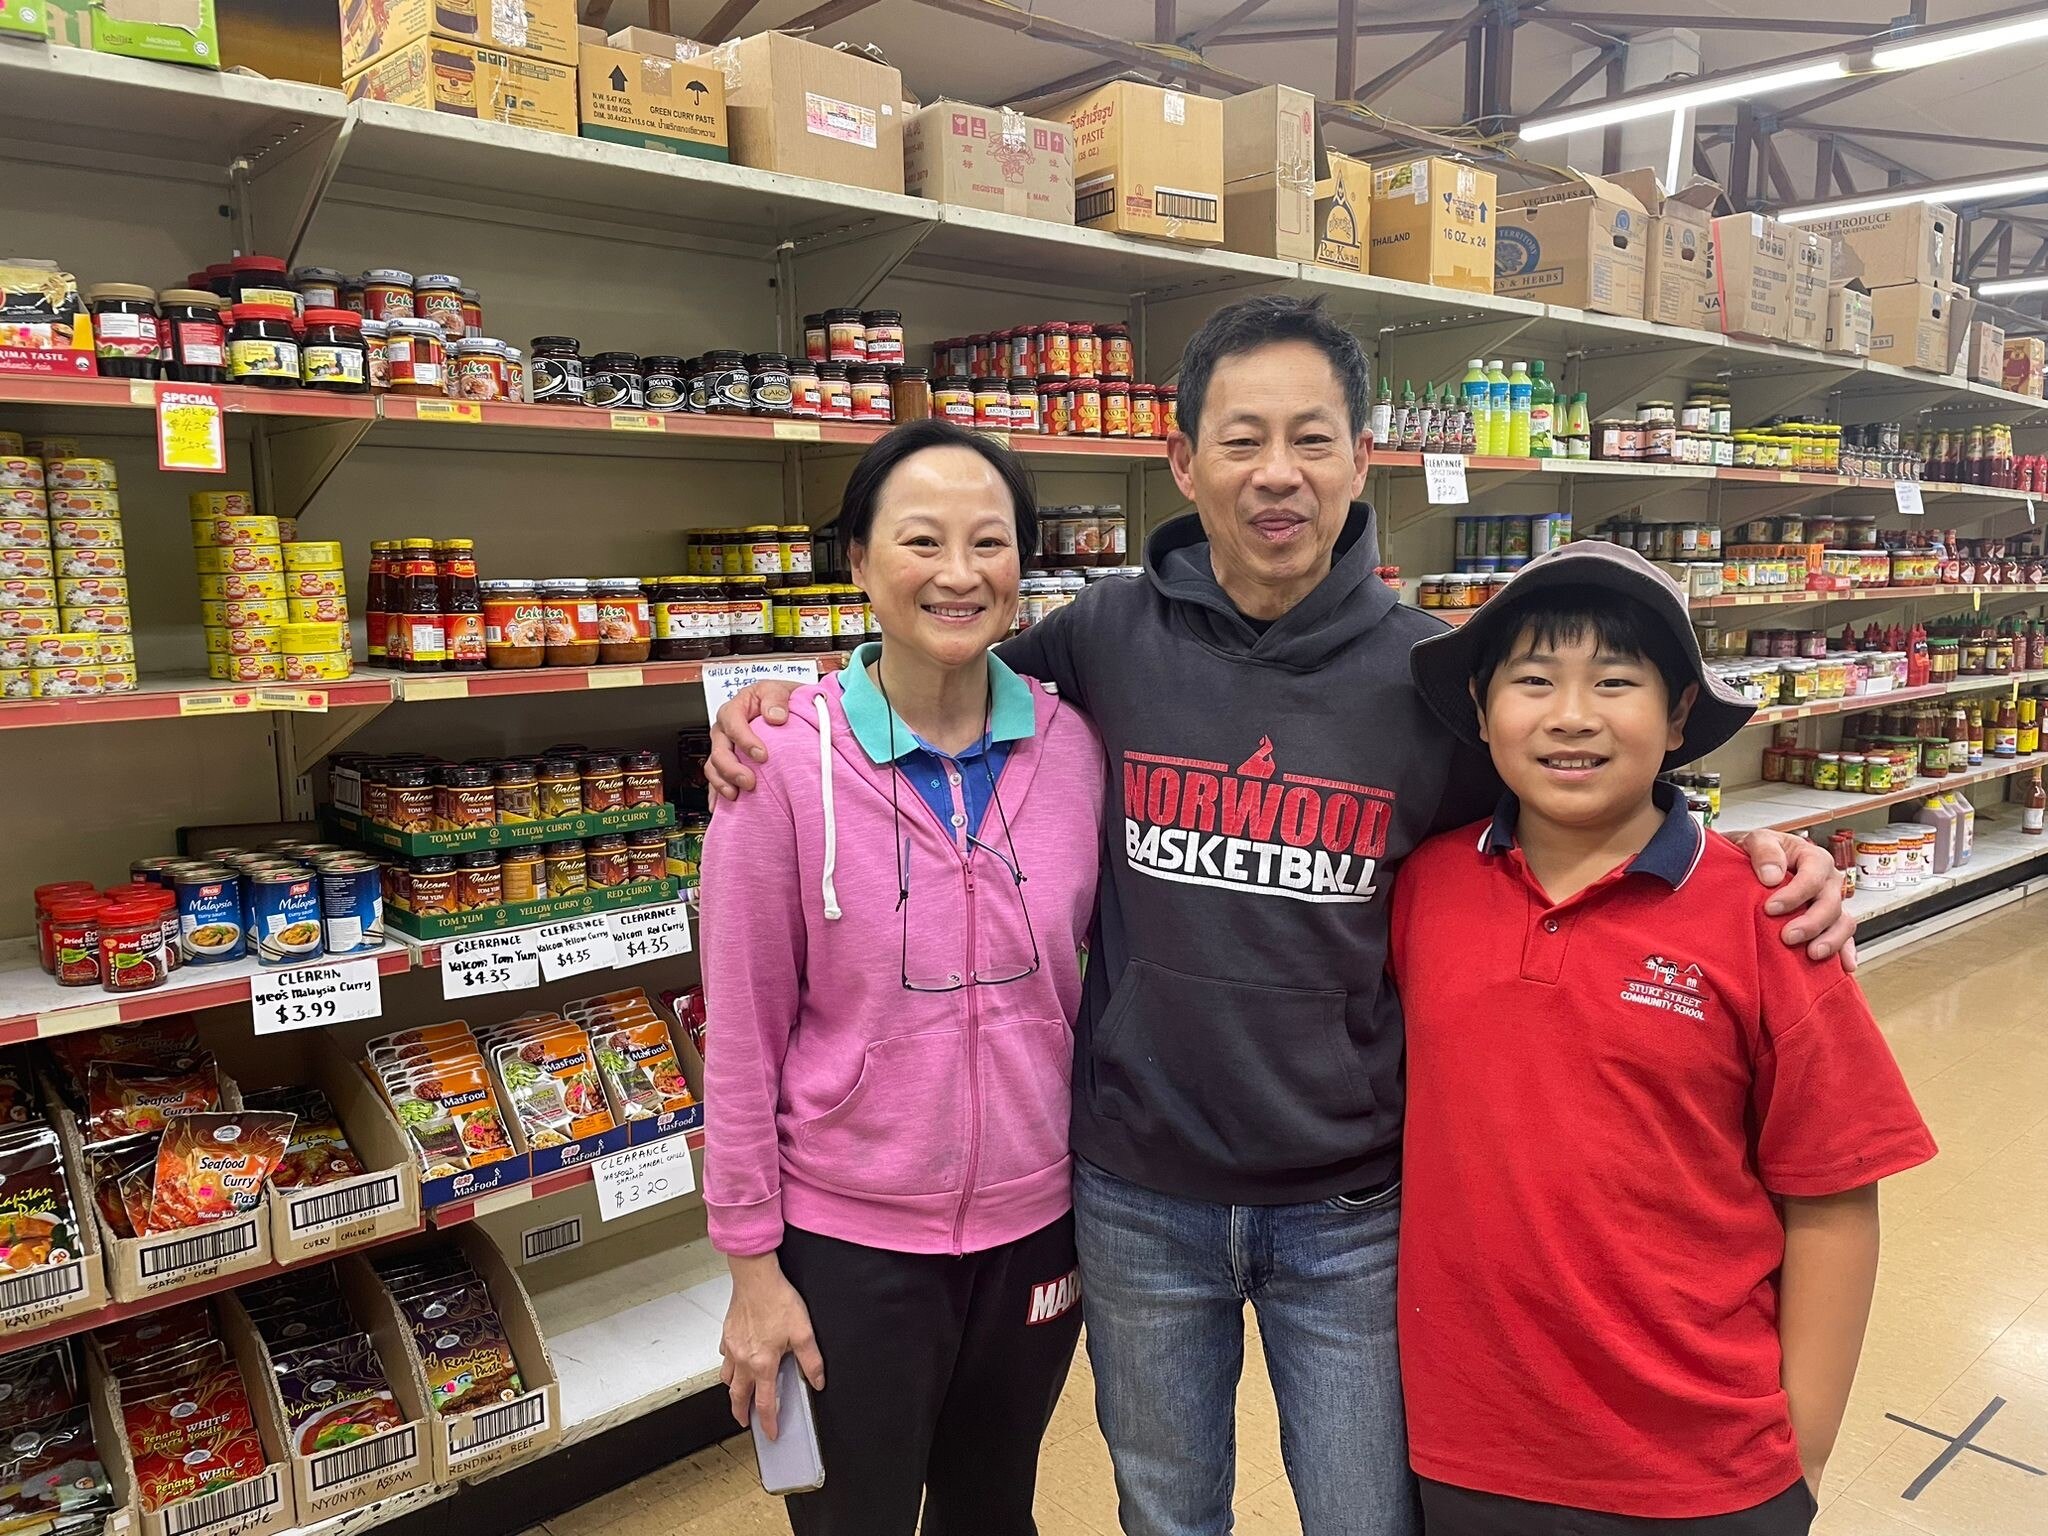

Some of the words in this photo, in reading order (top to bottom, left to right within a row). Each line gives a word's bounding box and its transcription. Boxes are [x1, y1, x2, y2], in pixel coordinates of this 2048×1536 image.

[649, 106, 672, 117] GREEN
[673, 110, 694, 121] CURRY
[695, 114, 715, 125] PASTE
[1081, 128, 1105, 146] PASTE
[1835, 212, 1892, 228] PRODUCE
[1372, 232, 1411, 248] THAILAND
[1443, 228, 1452, 241] 16
[1454, 230, 1468, 244] OZ.
[1476, 236, 1486, 248] 24
[1320, 242, 1334, 257] Por
[1336, 245, 1359, 265] Kwan
[1522, 274, 1559, 286] HERBS
[425, 296, 462, 311] Laksa
[0, 350, 28, 360] RIMA
[162, 392, 216, 406] SPECIAL
[602, 816, 620, 825] RED
[622, 812, 650, 822] CURRY
[1123, 761, 1392, 859] NORWOOD
[430, 834, 452, 844] TOM
[454, 831, 477, 842] YUM
[511, 825, 544, 837] YELLOW
[546, 822, 573, 833] CURRY
[1125, 817, 1378, 895] BASKETBALL
[607, 889, 624, 899] RED
[626, 885, 653, 897] CURRY
[189, 900, 233, 912] Malaysia
[278, 897, 317, 911] Malaysia
[520, 904, 551, 916] YELLOW
[554, 900, 580, 911] CURRY
[438, 916, 459, 927] TOM
[462, 913, 484, 924] YUM
[620, 906, 677, 925] CLEARANCE
[540, 917, 605, 938] CLEARANCE
[613, 930, 643, 943] Valcom
[648, 925, 660, 935] Red
[662, 922, 685, 934] Curry
[64, 937, 83, 945] Dried
[119, 940, 140, 950] Dried
[455, 935, 521, 955] CLEARANCE
[563, 935, 587, 948] Yellow
[588, 930, 609, 942] Curry
[627, 936, 669, 957] $4.35
[492, 952, 514, 965] Tom
[517, 950, 537, 962] Yum
[557, 949, 591, 967] $4.35
[463, 968, 511, 986] $4.35
[292, 985, 336, 1000] Malaysia
[340, 980, 371, 992] Curry
[1629, 982, 1662, 998] STURT
[1664, 990, 1702, 1008] STREET
[275, 1000, 336, 1025] $3.99
[1620, 990, 1672, 1010] COMMUNITY
[1673, 1003, 1705, 1021] SCHOOL
[631, 1043, 667, 1061] MasFood
[546, 1053, 586, 1073] MasFood
[136, 1091, 184, 1107] Seafood
[443, 1090, 486, 1108] MasFood
[163, 1107, 196, 1117] Curry
[657, 1117, 694, 1134] MasFood
[200, 1157, 247, 1171] Seafood
[562, 1148, 600, 1167] MasFood
[601, 1143, 669, 1170] CLEARANCE
[223, 1174, 256, 1188] Curry
[453, 1178, 498, 1198] MasFood
[234, 1191, 256, 1204] Pas
[19, 1199, 58, 1219] Paste
[303, 1236, 331, 1250] CURRY
[341, 1223, 375, 1240] CHICKEN
[54, 1250, 67, 1264] 20
[1030, 1270, 1081, 1322] MAR
[5, 1304, 64, 1328] KAPITAN
[442, 1347, 501, 1370] Rendang
[474, 1362, 503, 1379] Paste
[285, 1397, 334, 1419] Nyonya
[143, 1428, 182, 1445] Penang
[186, 1412, 232, 1433] WHITE
[379, 1423, 390, 1432] 20
[153, 1436, 184, 1450] Curry
[187, 1424, 224, 1441] Noodle
[510, 1438, 535, 1453] BEEF
[155, 1475, 196, 1494] Penang
[311, 1487, 366, 1513] NYONYA
[376, 1470, 412, 1491] ASSAM
